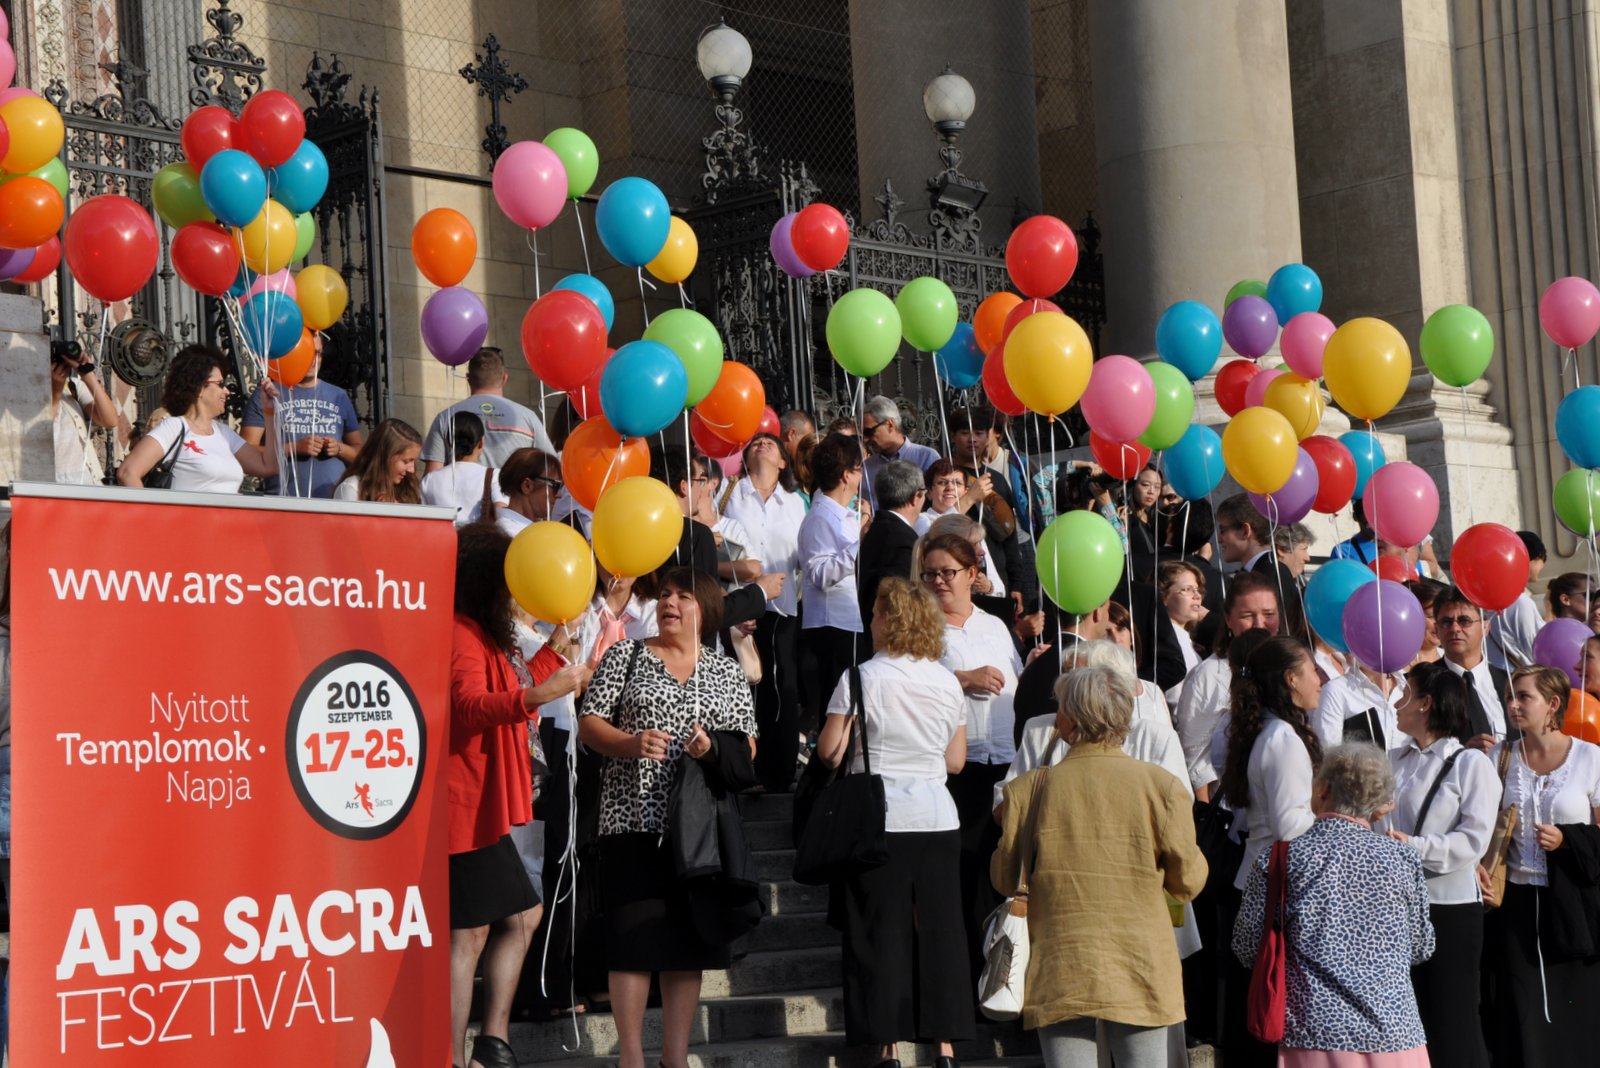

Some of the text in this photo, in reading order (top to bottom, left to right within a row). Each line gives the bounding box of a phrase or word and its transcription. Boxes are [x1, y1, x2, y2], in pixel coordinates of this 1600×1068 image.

[284, 425, 336, 434] ORIGINALS
[48, 567, 427, 611] www.ars-sacra.hu
[150, 691, 250, 733] Nyitott
[327, 680, 391, 710] 2016
[328, 710, 393, 724] SZEPTEMBER
[56, 731, 252, 772] Templomok
[304, 728, 413, 773] 17-25.
[166, 770, 252, 809] Napja
[345, 798, 393, 810] Ars Sacra
[56, 885, 433, 981] ARS SACRA
[56, 959, 354, 1054] FESZTIVÁL
